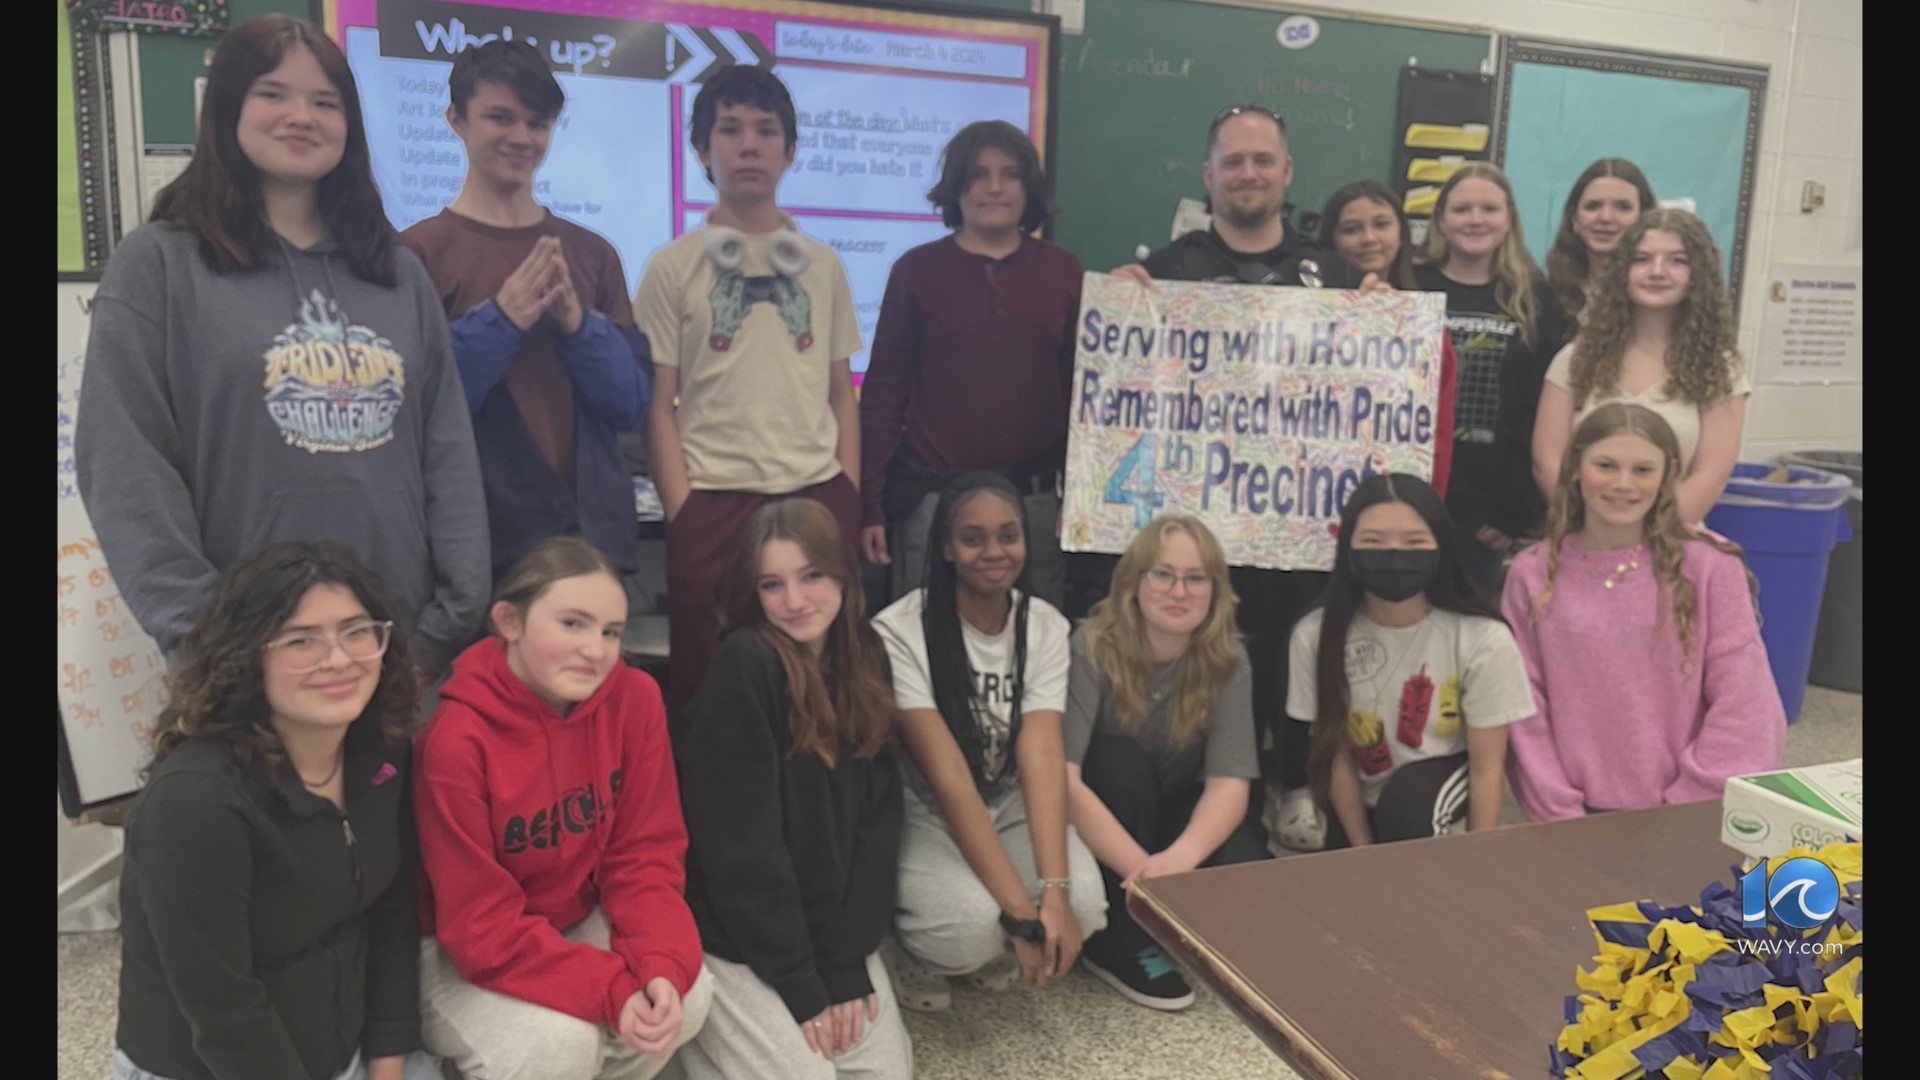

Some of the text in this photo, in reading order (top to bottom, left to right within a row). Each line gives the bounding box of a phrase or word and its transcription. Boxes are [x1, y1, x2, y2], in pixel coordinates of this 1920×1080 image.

[551, 33, 616, 76] up?
[397, 101, 425, 119] Art
[837, 110, 865, 129] the
[400, 147, 462, 168] Update
[823, 131, 858, 152] that
[1080, 308, 1430, 379] Serving with Honor,
[267, 399, 405, 443] CHALLENGE
[1079, 368, 1432, 445] Remembered with Pride
